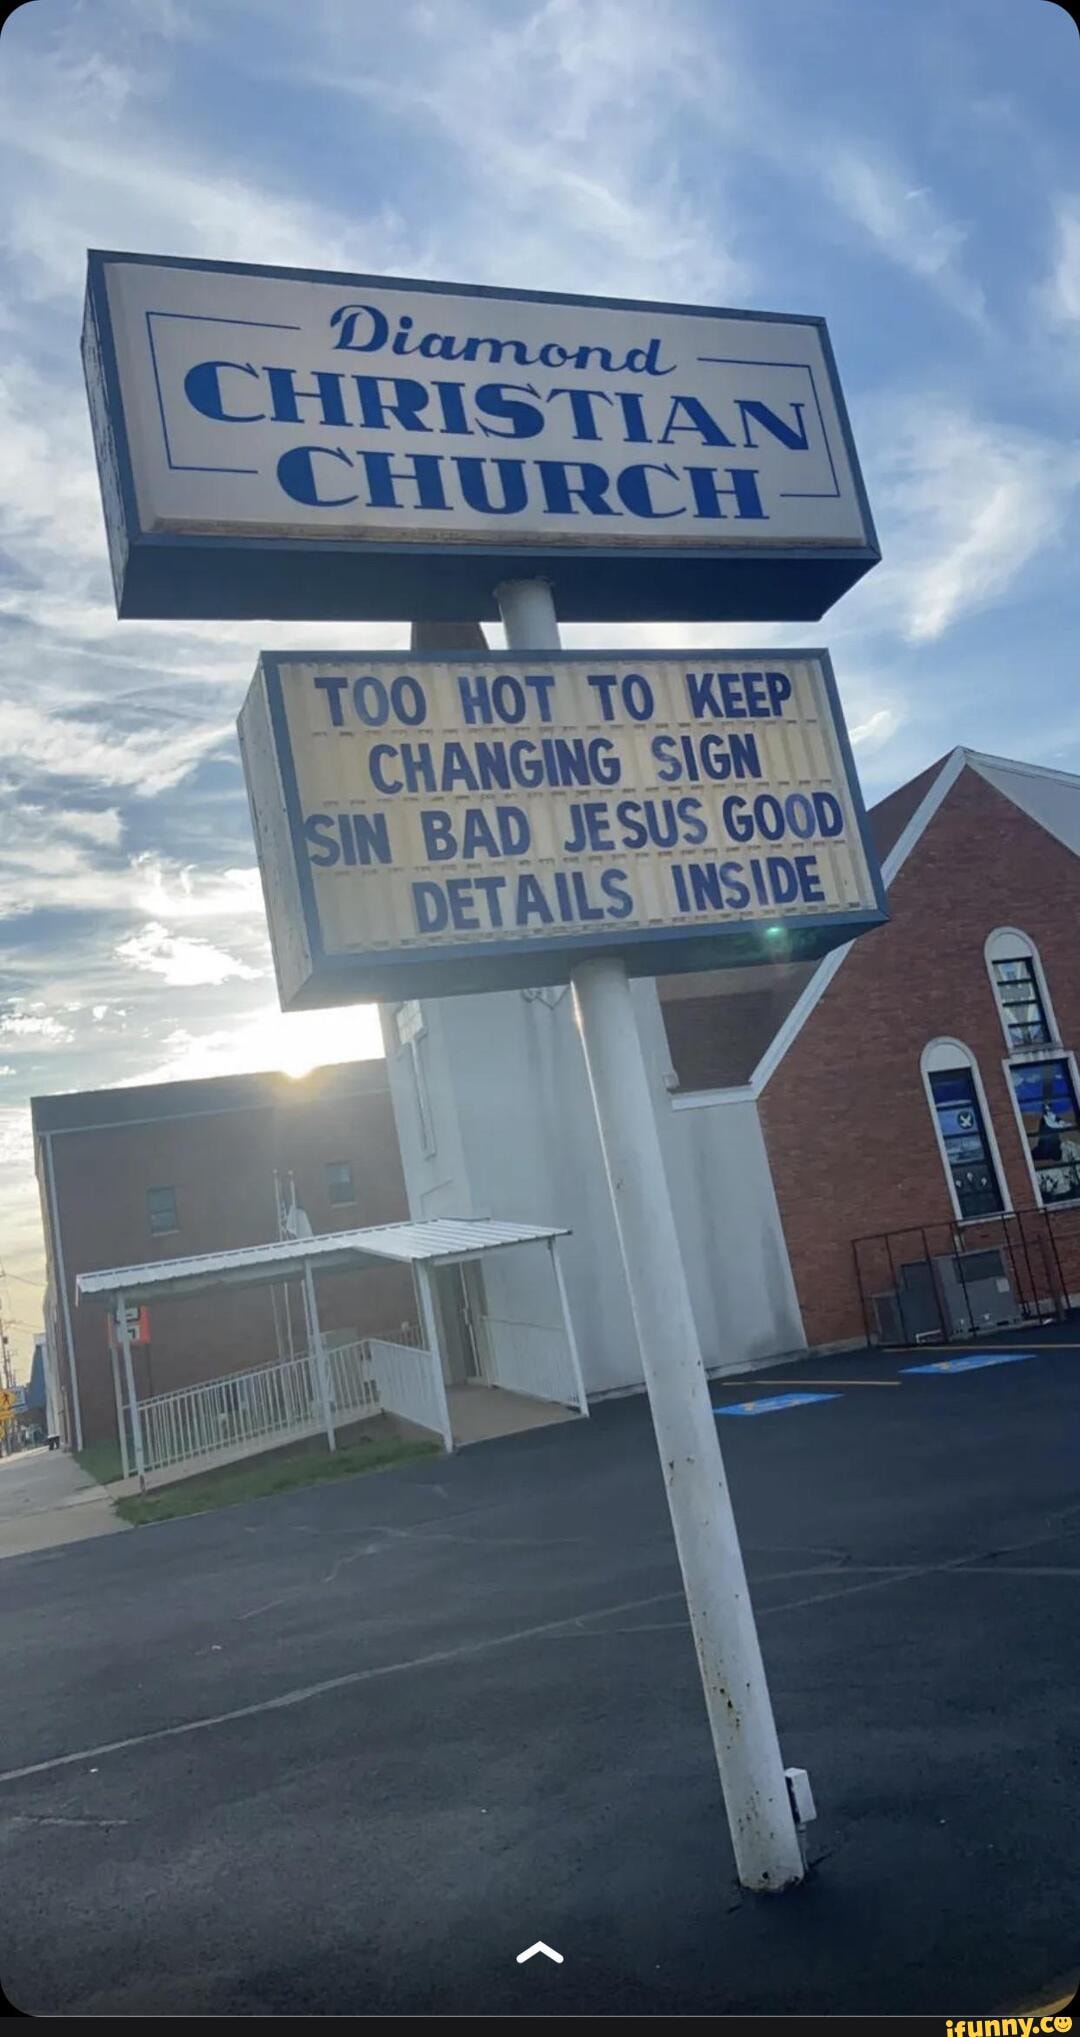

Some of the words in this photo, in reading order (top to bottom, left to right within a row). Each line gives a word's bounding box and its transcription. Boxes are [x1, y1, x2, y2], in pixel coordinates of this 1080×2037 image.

[330, 304, 677, 376] Diamond
[184, 361, 809, 451] CHRISTIAN
[276, 446, 770, 520] CHURCH
[314, 676, 427, 727] TOO
[458, 675, 555, 725] HOT
[587, 674, 655, 721] TO
[686, 672, 792, 718] KEEP
[369, 738, 621, 794] CHANGING
[651, 733, 762, 782] SIGN
[304, 813, 392, 867] SIN
[421, 806, 532, 862] BAD
[565, 797, 708, 853] JESUS
[722, 792, 844, 842] GOOD
[411, 868, 633, 933] DETAILS
[671, 856, 826, 912] INSIDE
